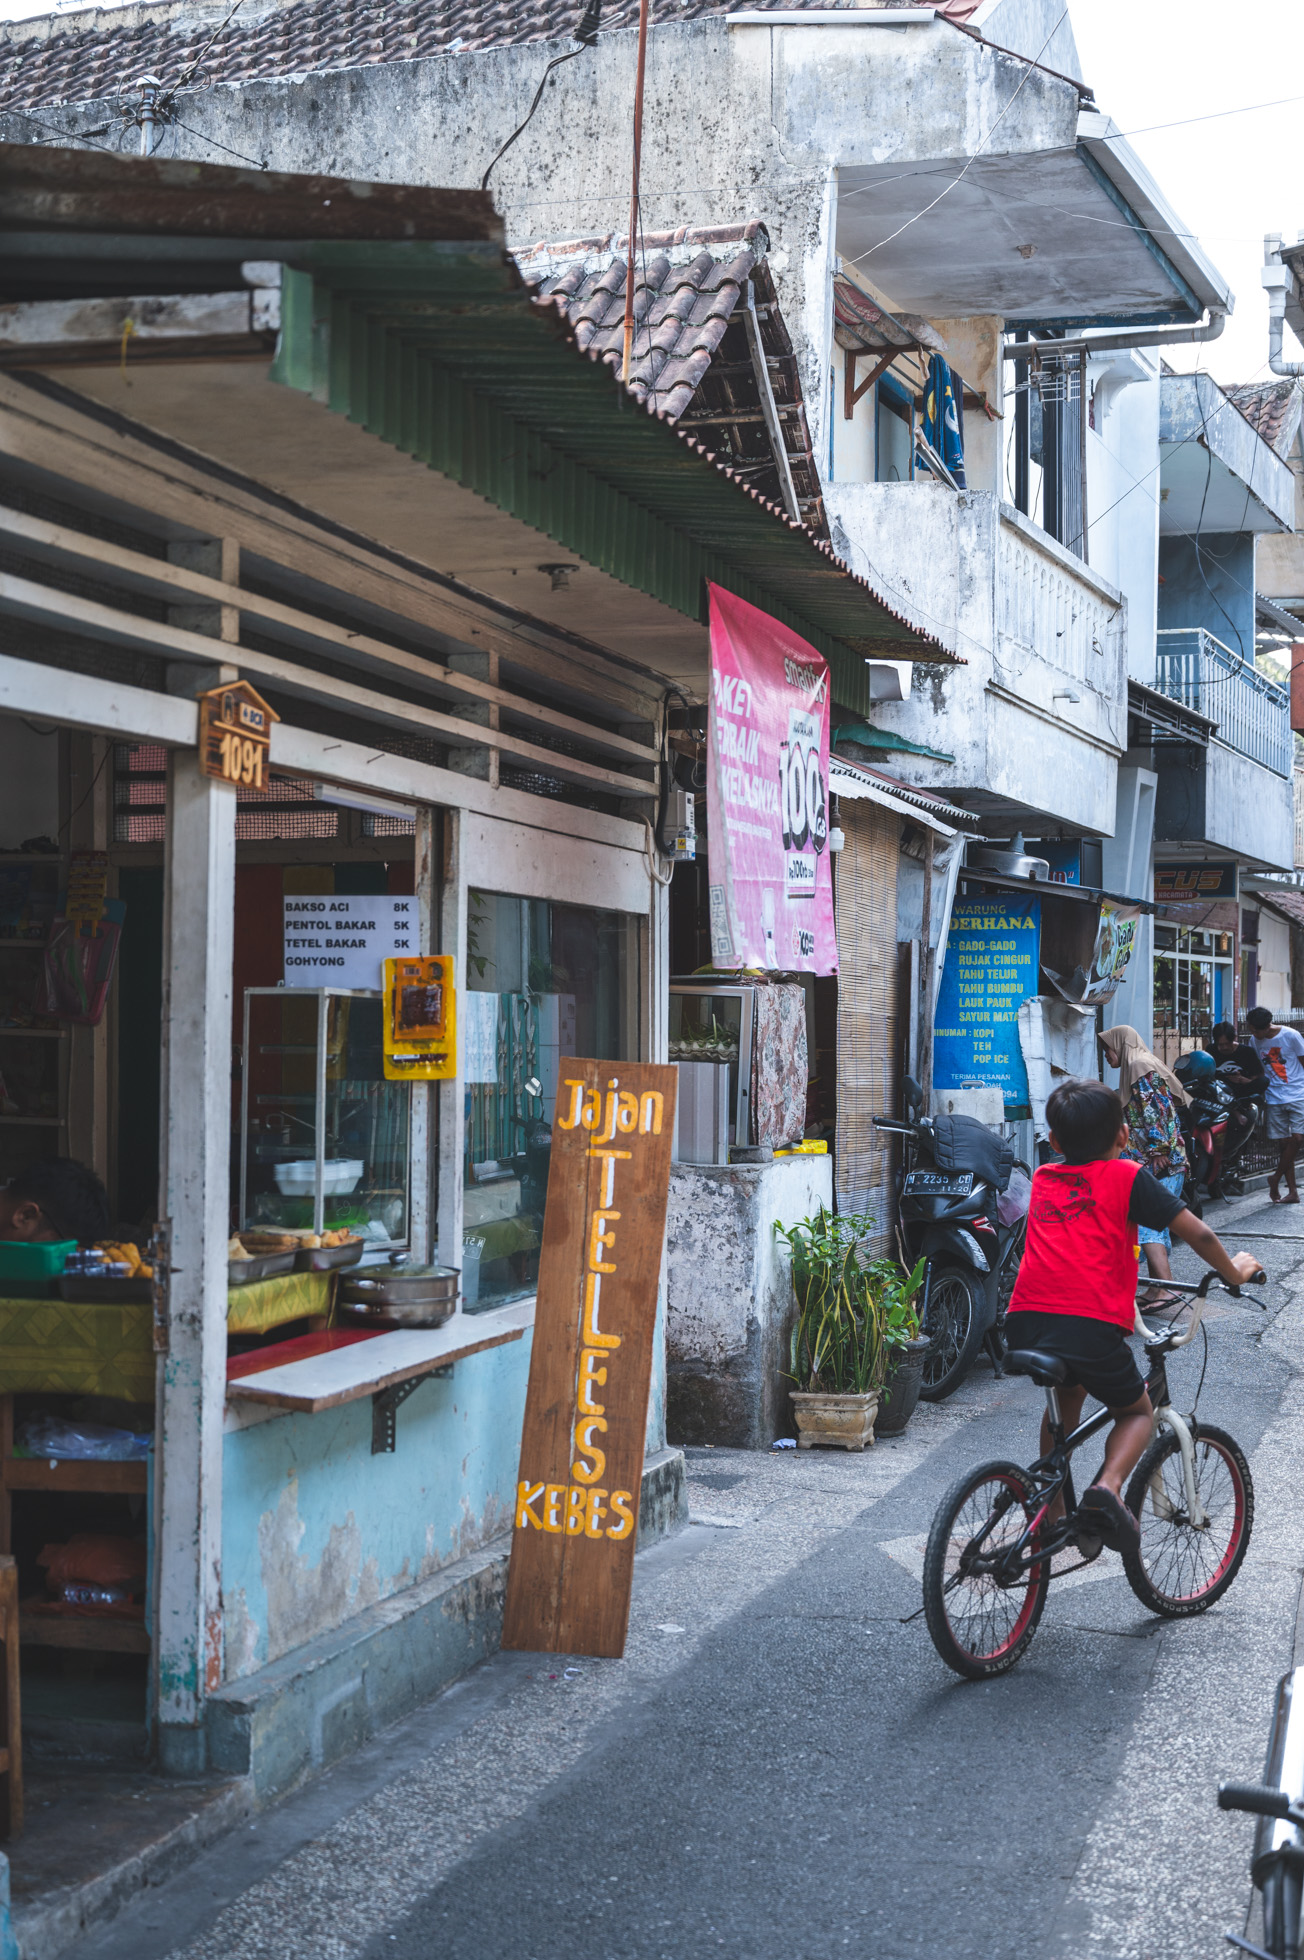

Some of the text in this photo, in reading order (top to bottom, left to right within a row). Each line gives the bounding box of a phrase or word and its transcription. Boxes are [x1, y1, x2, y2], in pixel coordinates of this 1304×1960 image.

[716, 717, 761, 766] ERBAIK
[220, 732, 263, 787] 1091
[779, 740, 824, 850] 100
[285, 902, 409, 912] BAKSO ACI 8K
[954, 904, 1006, 915] WARUNG
[285, 920, 409, 930] PENTOL BAKAR 5K
[285, 938, 409, 948] TETEL BAKAR 5K
[958, 940, 1016, 951] GADO-GADO
[285, 956, 345, 966] GOHYONG
[958, 954, 1031, 966] RUJAK CINGUR
[959, 969, 1017, 980] TAHU TELUR
[959, 983, 1024, 994] TAHU BUMBU
[959, 997, 1012, 1008] LAUK PAUK
[959, 1012, 990, 1022] SAYUR
[973, 1029, 994, 1038] KOPI
[973, 1041, 991, 1051] TEH
[973, 1054, 1009, 1063] POP ICE
[558, 1077, 664, 1144] Jajan
[923, 1174, 949, 1184] 2235
[572, 1148, 632, 1484] TELES
[515, 1480, 635, 1540] KEBES
